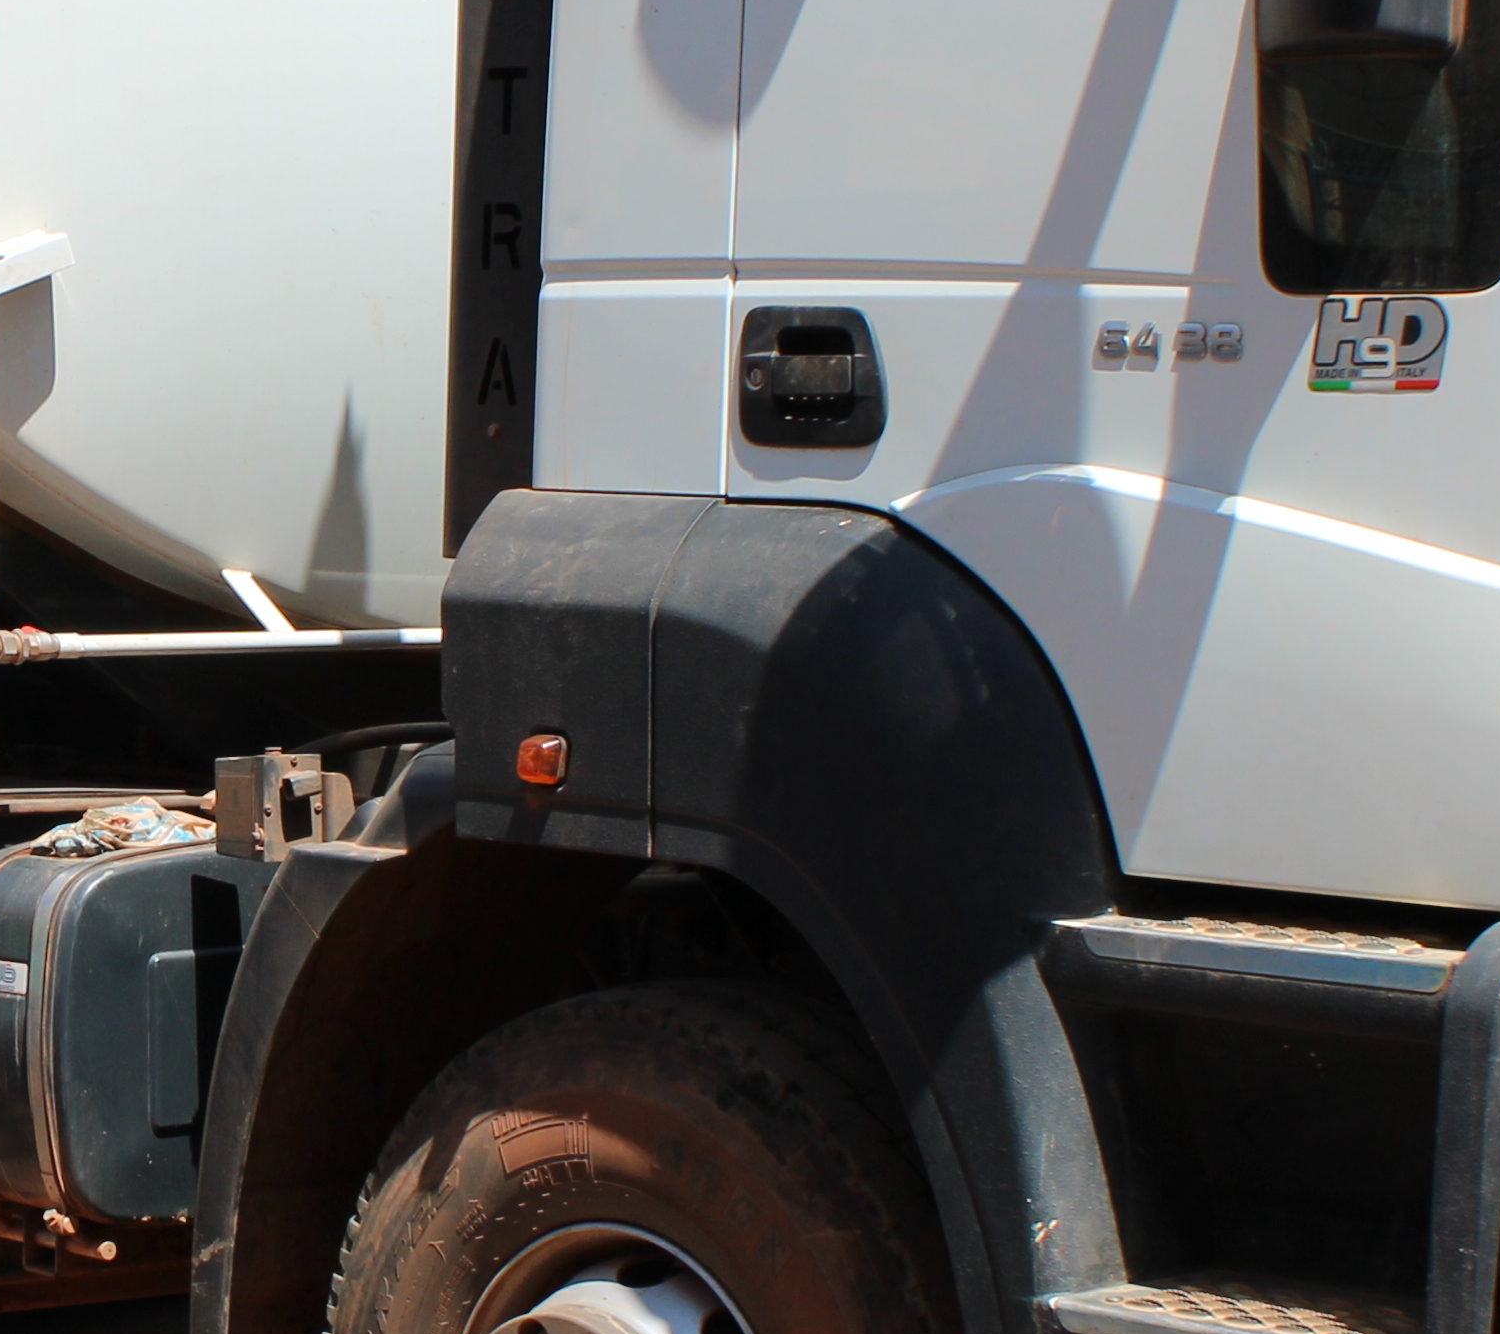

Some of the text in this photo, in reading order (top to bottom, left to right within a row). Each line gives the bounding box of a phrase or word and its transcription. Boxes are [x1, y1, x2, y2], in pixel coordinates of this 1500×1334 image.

[1315, 368, 1426, 379] MADE IN ITALY
